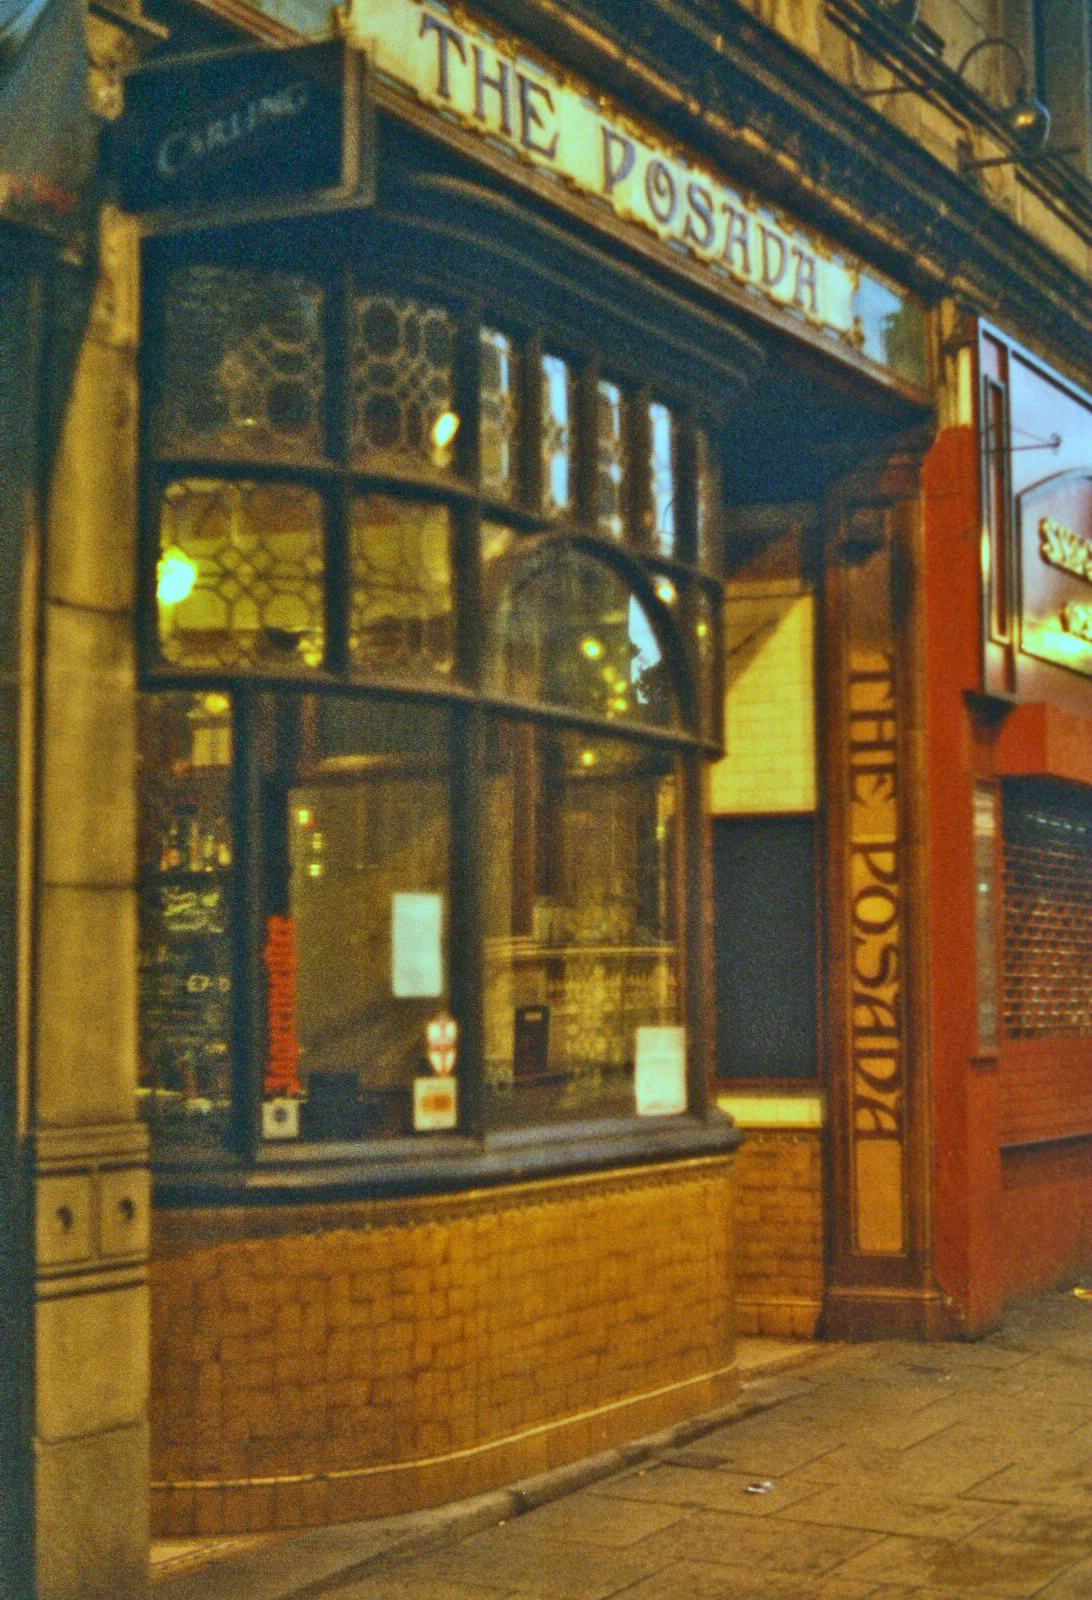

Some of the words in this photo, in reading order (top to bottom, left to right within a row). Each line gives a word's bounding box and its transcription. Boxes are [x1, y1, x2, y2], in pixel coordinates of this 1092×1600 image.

[419, 13, 560, 161] THE
[601, 124, 818, 316] POSADA
[849, 651, 898, 805] THE
[850, 843, 900, 1140] POSADA
